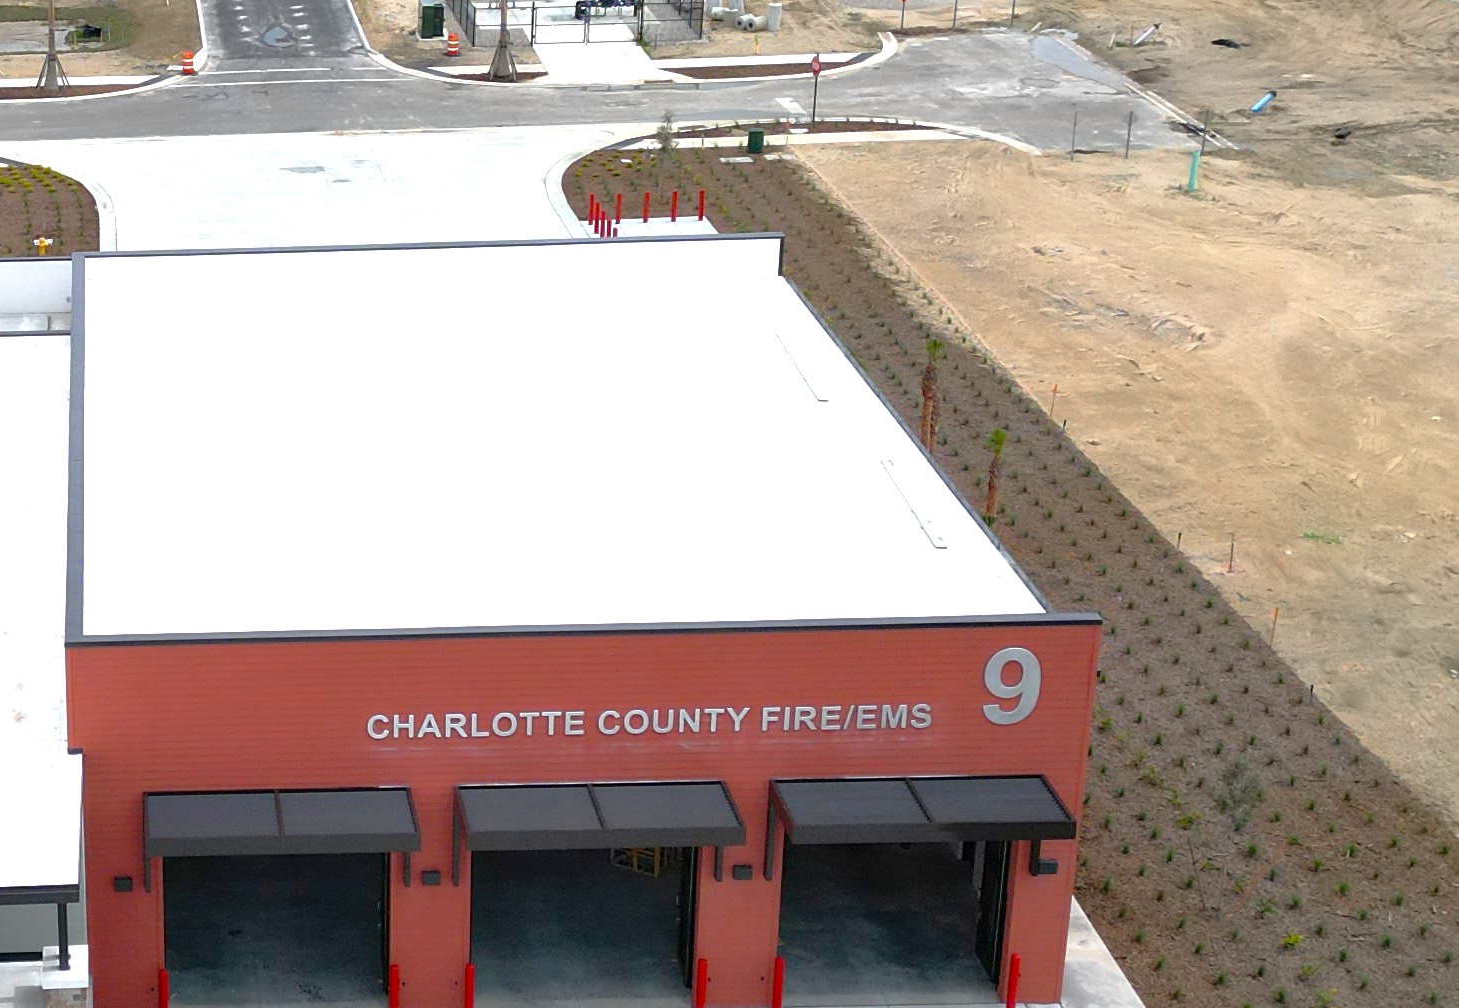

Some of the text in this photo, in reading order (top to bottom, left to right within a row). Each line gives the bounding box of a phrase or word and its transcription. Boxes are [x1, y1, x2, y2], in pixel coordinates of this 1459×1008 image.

[982, 647, 1042, 725] 9
[366, 703, 933, 740] CHARLOTTE COUNTY FIRE/EMS
